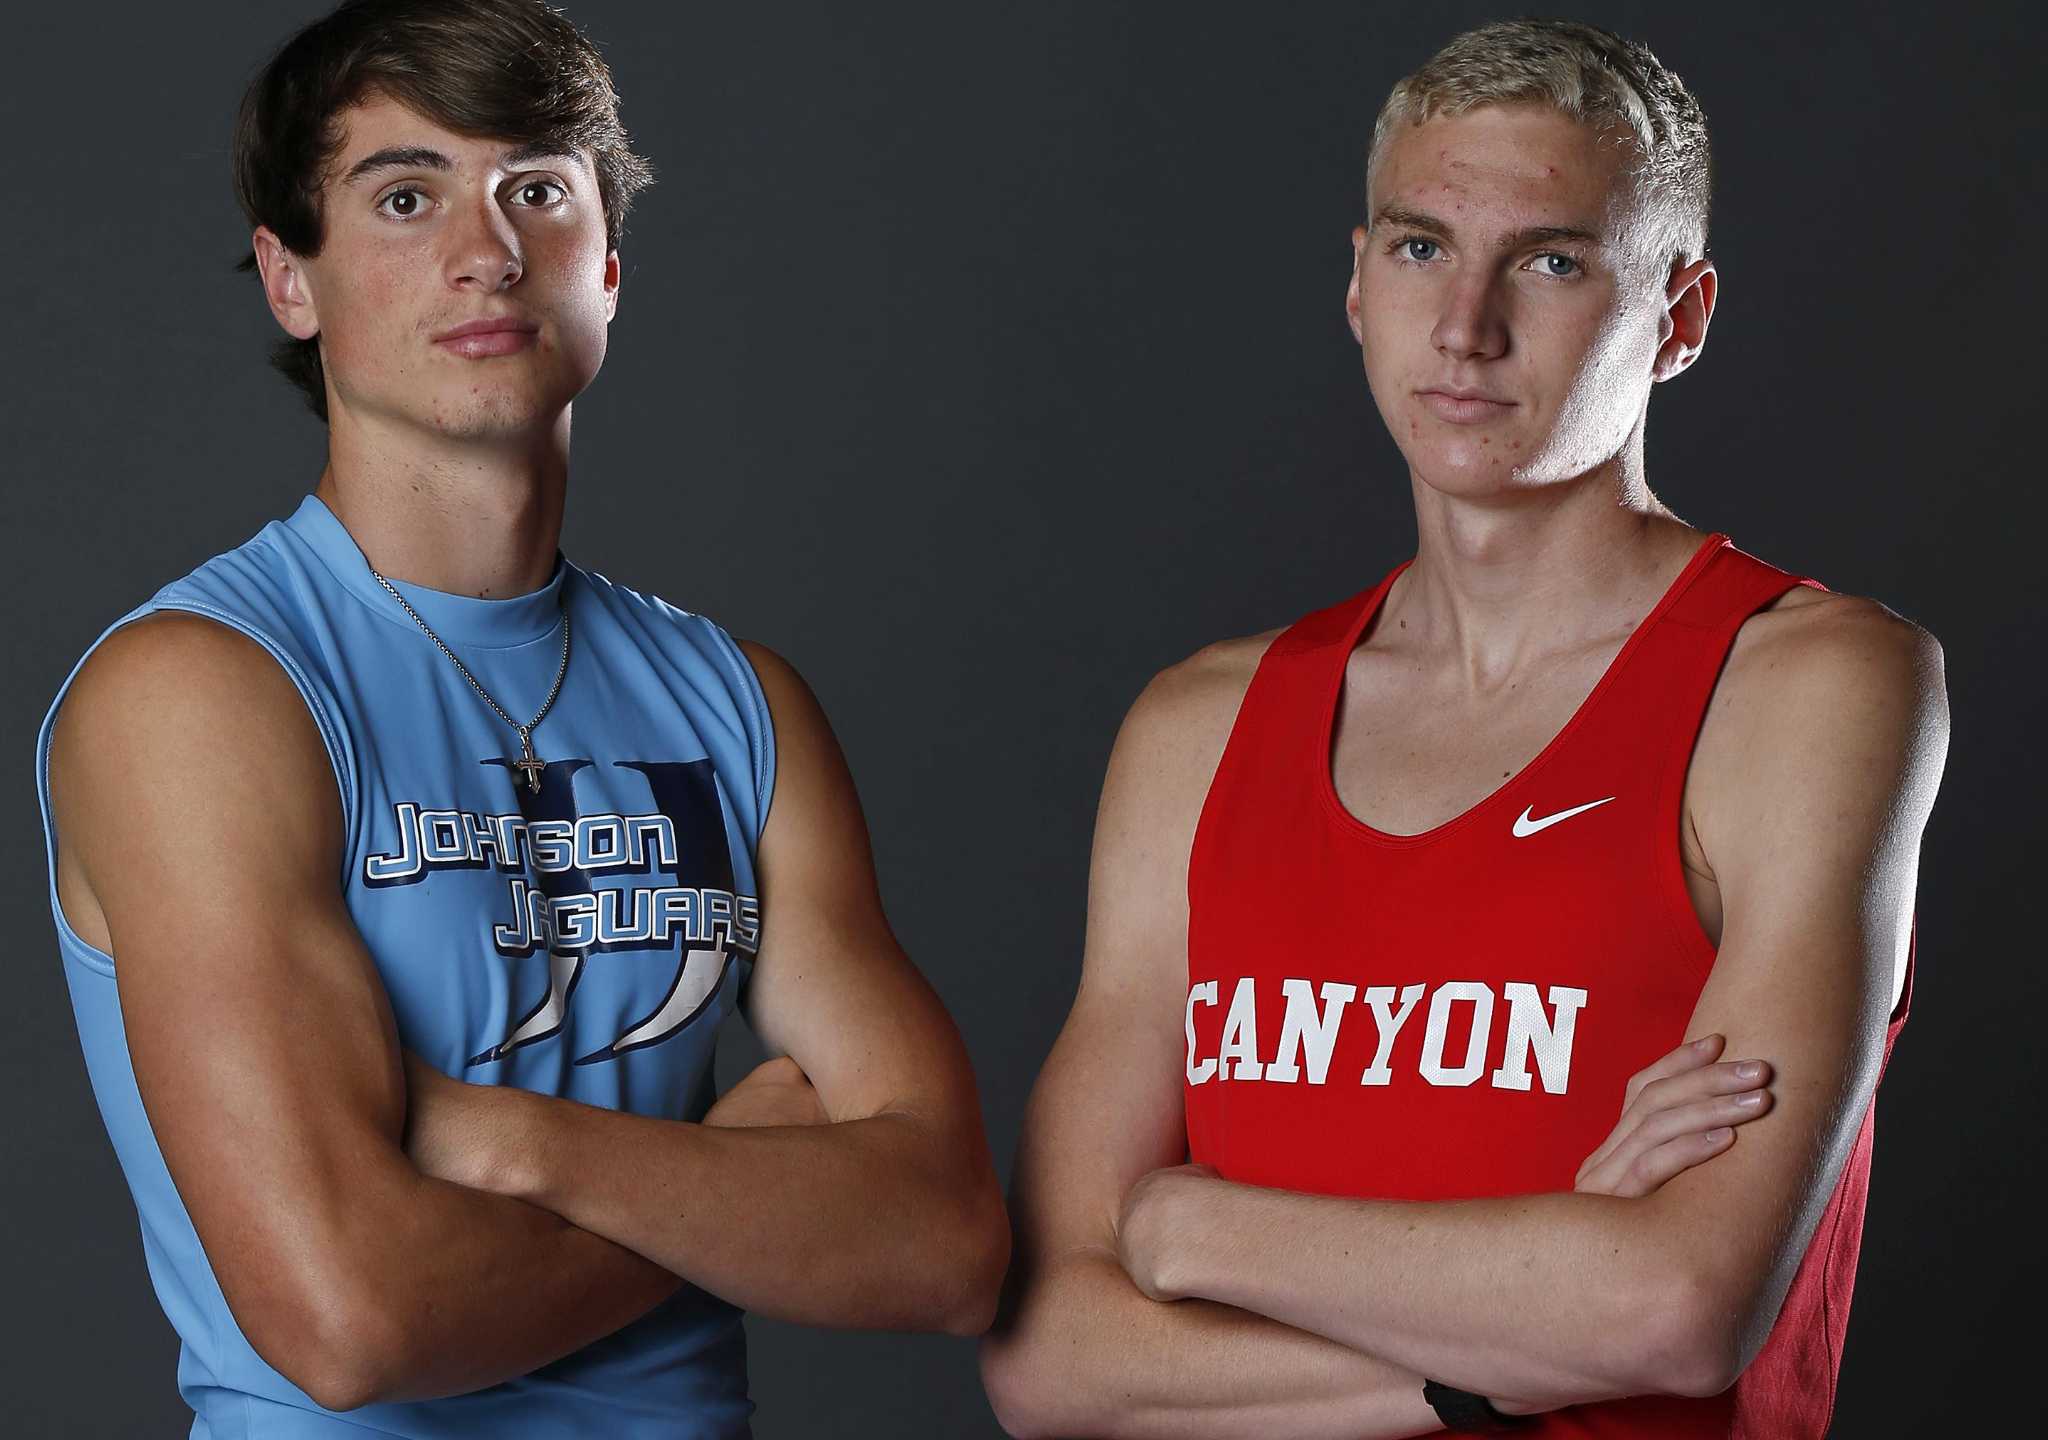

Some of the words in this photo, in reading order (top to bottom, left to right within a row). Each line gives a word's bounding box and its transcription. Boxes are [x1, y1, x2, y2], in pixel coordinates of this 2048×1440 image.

[364, 802, 679, 887] JOHNSON
[494, 879, 760, 955] JAGUARS
[1185, 977, 1589, 1095] CANYON
